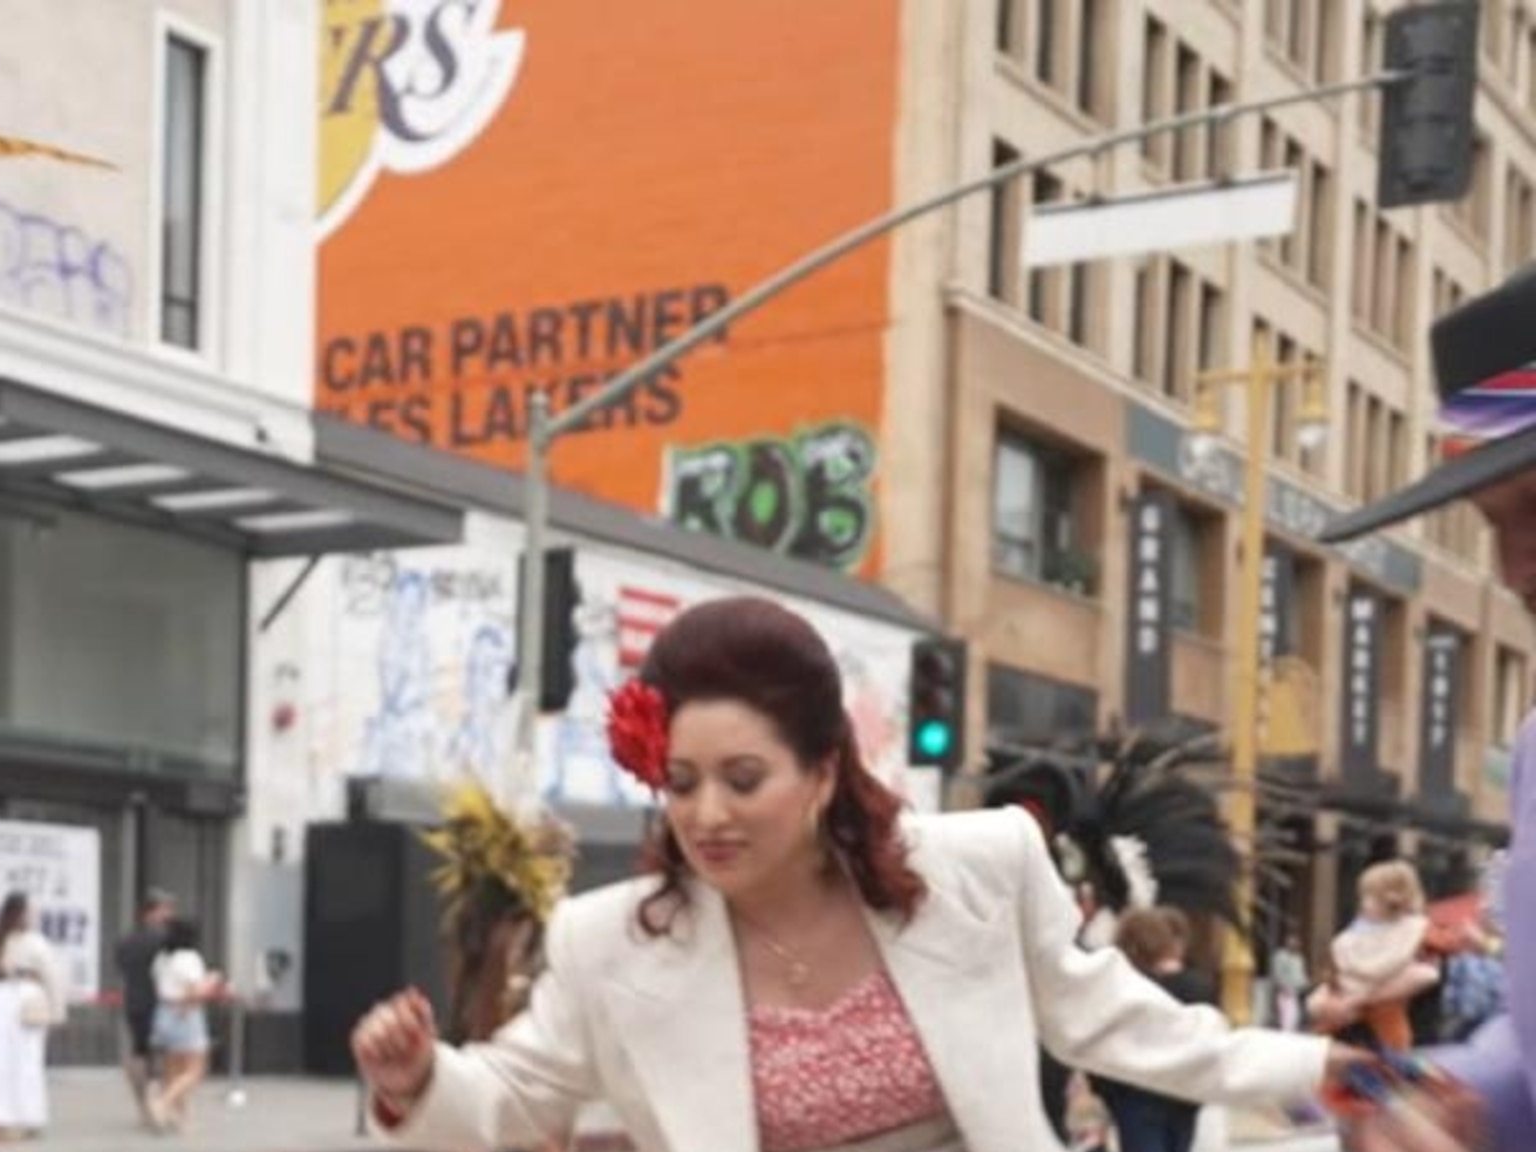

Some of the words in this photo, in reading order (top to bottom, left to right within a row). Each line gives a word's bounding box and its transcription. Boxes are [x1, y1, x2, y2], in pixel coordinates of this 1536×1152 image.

[322, 0, 476, 142] RS
[323, 325, 432, 391] CAR
[451, 284, 729, 376] PARTNER
